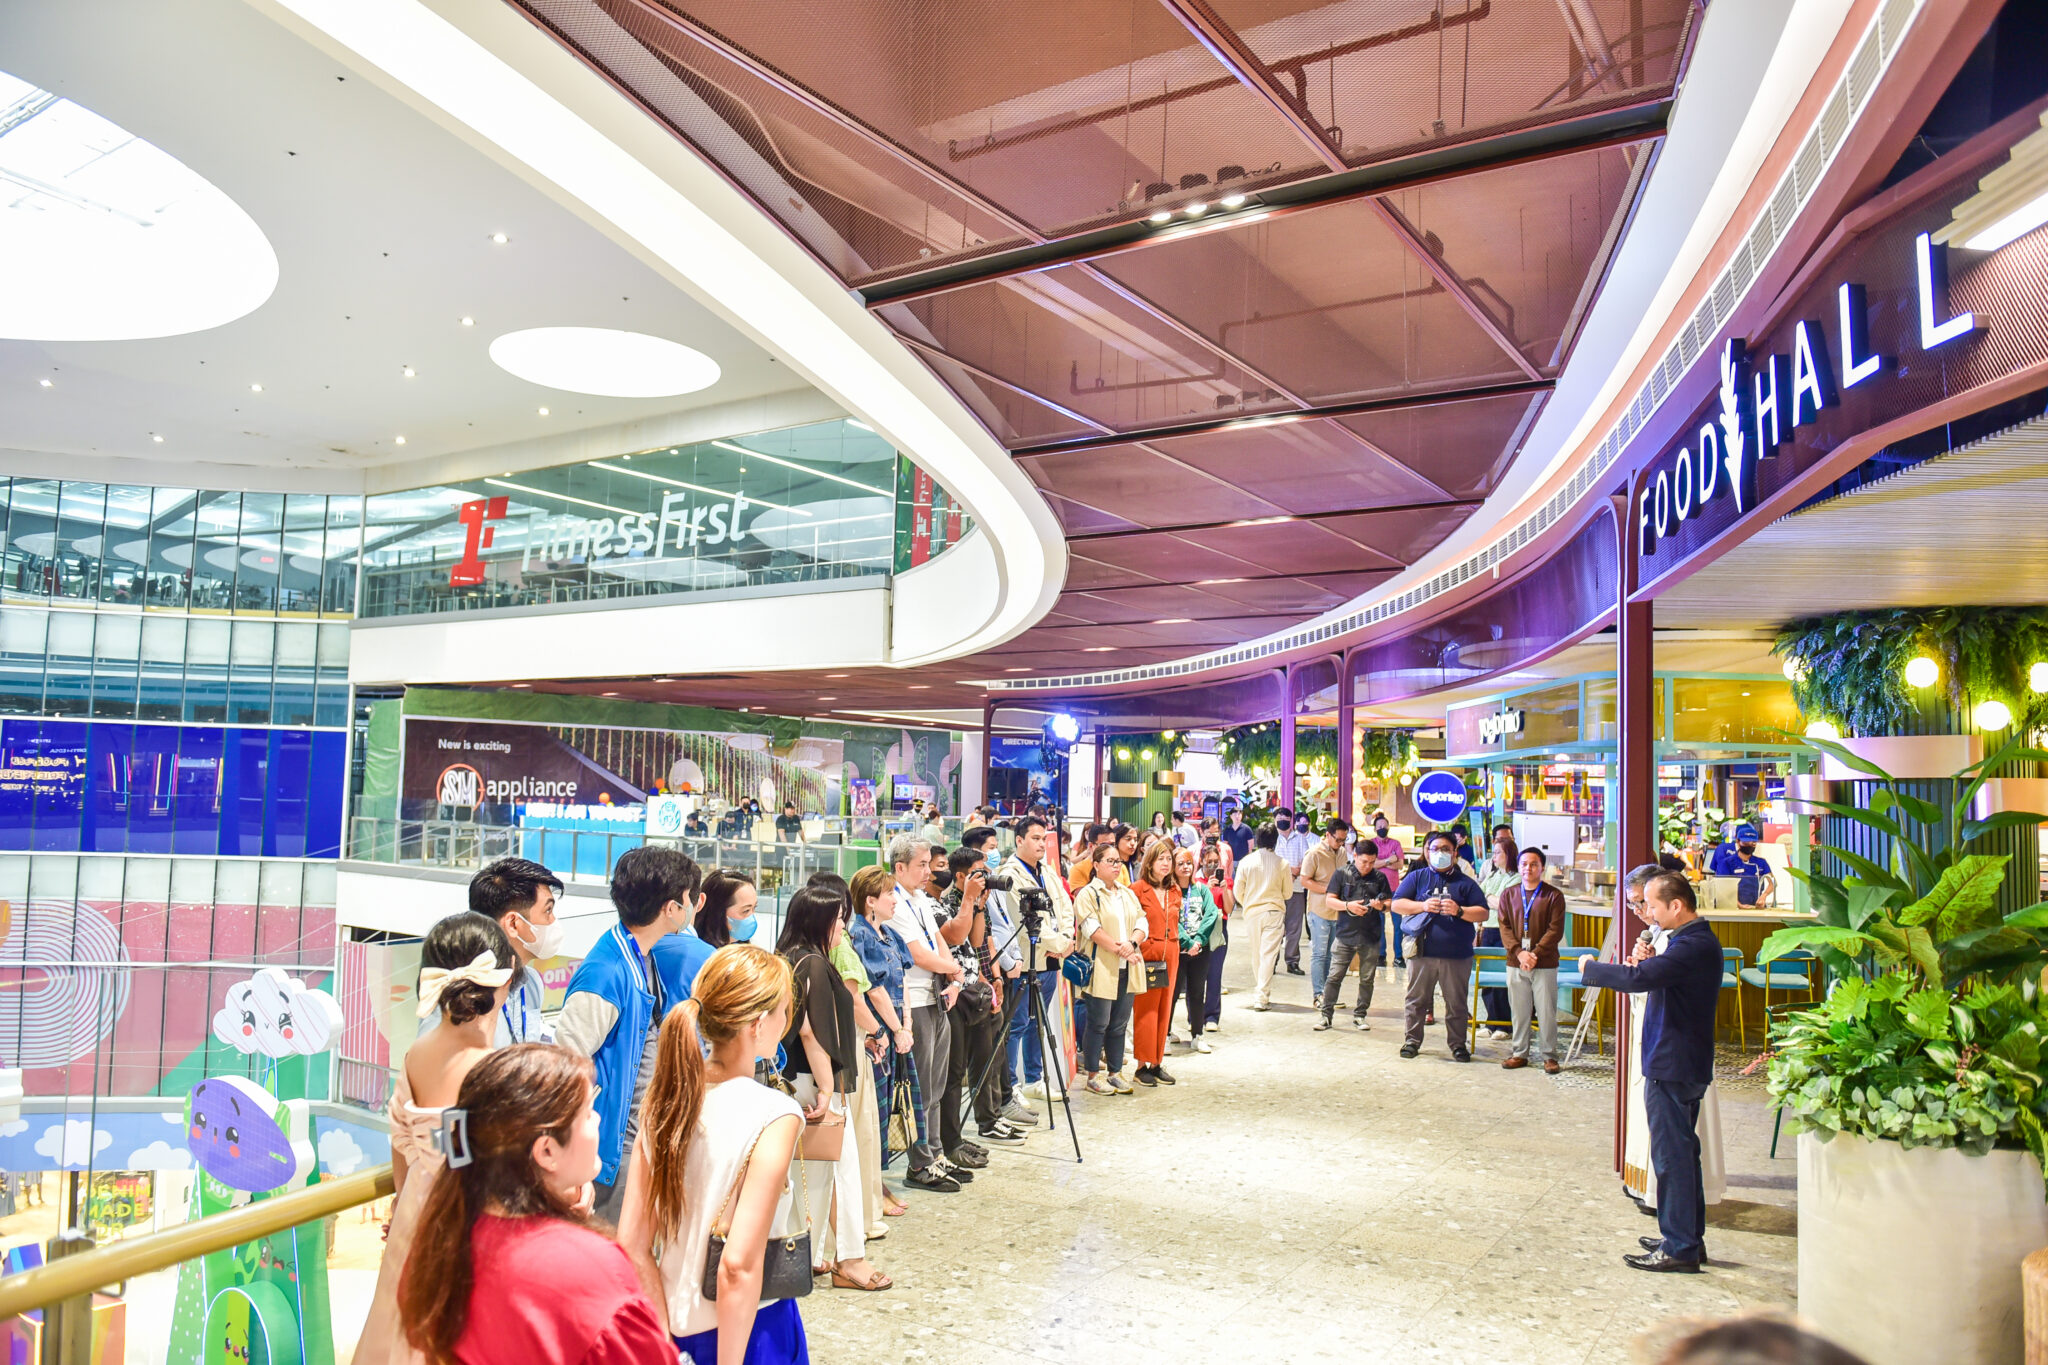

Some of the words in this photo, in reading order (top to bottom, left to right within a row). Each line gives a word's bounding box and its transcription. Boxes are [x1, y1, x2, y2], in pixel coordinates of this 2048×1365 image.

[1638, 421, 1719, 557] FOOD
[1754, 230, 1975, 460] HALL
[438, 738, 461, 750] New
[463, 740, 471, 750] is
[473, 741, 511, 753] exciting
[486, 776, 577, 806] appliance
[1418, 790, 1465, 804] yogorino
